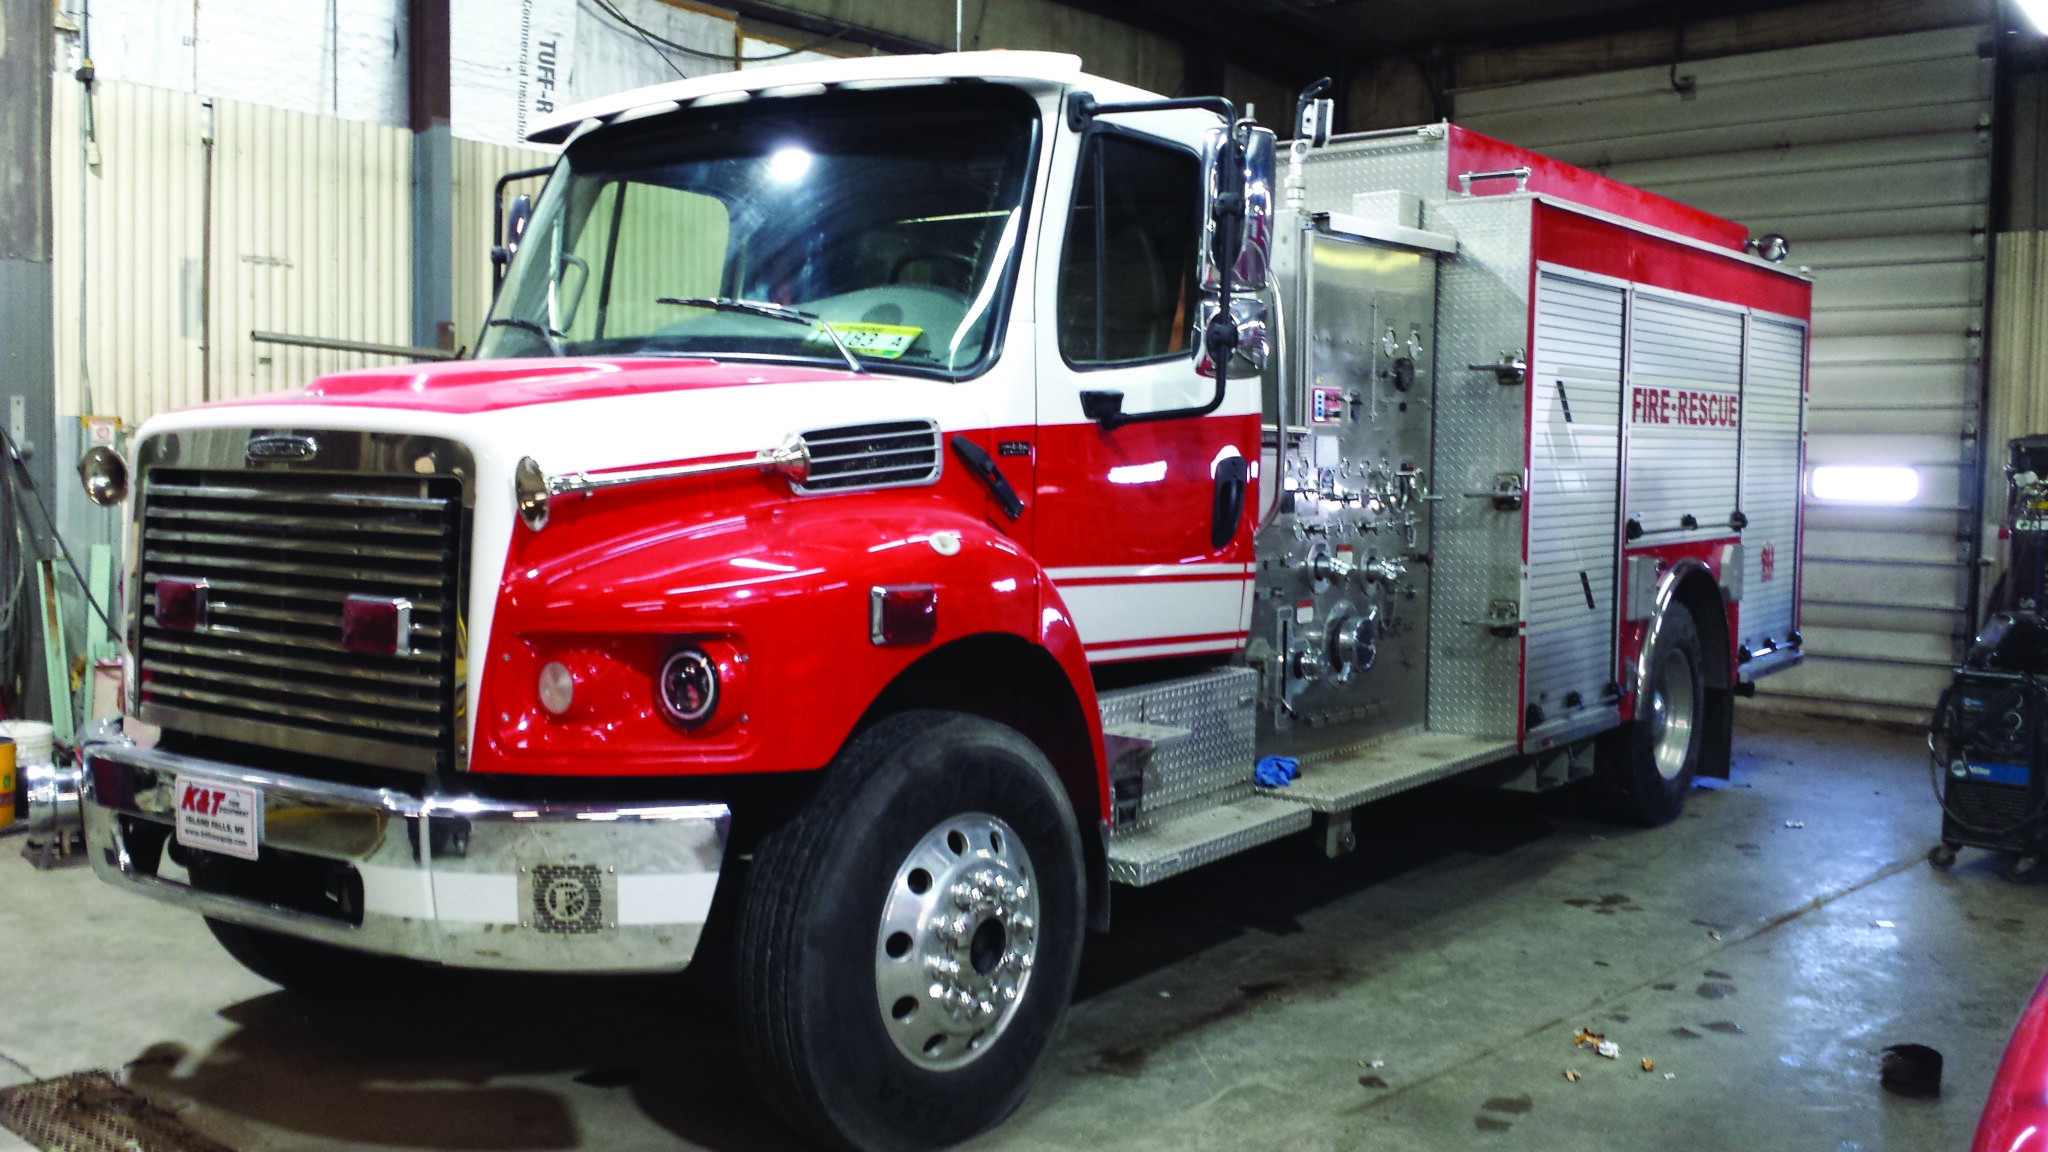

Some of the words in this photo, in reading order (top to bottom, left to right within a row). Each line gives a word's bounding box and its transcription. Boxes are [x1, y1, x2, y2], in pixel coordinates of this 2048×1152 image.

[519, 0, 532, 77] Commercial
[536, 40, 556, 114] TUFF-R
[517, 80, 528, 143] Insulation
[1632, 387, 1737, 427] FIRE-RESCUE
[181, 786, 226, 817] K&T
[186, 816, 210, 828] ISLAND
[211, 820, 233, 833] FALLS,
[234, 825, 245, 834] ME
